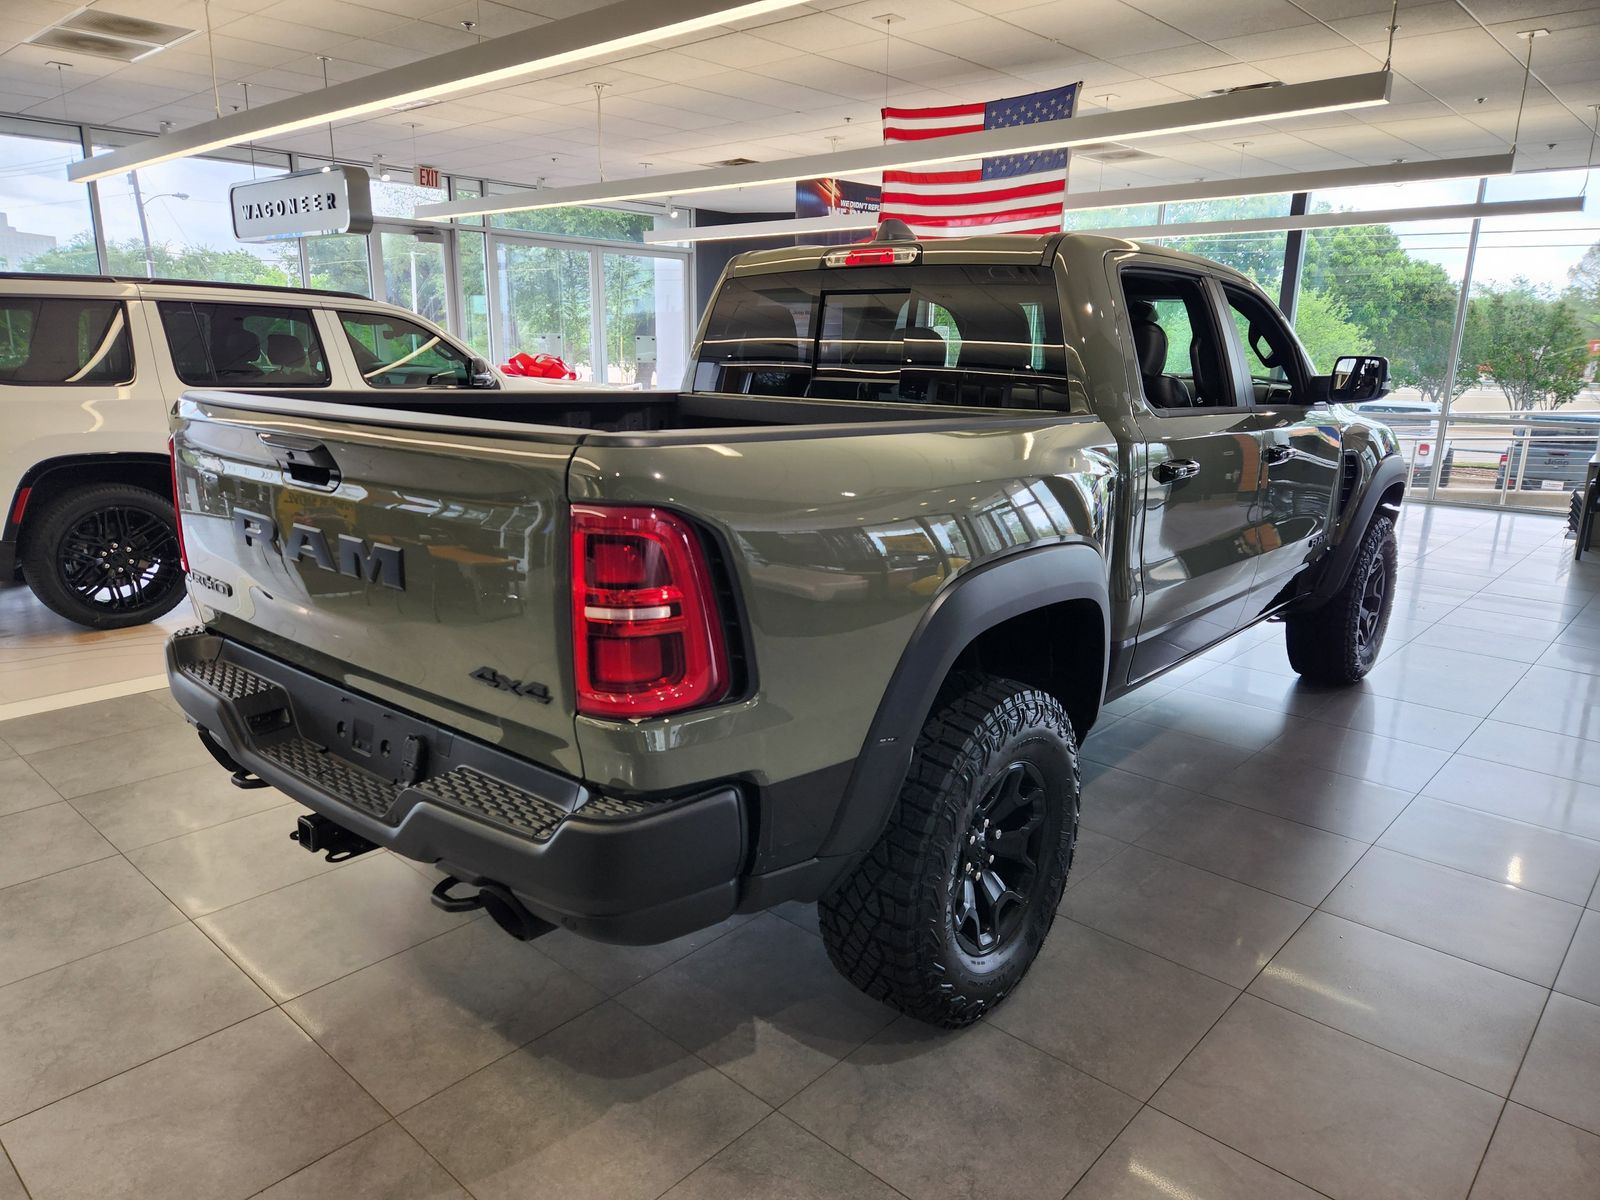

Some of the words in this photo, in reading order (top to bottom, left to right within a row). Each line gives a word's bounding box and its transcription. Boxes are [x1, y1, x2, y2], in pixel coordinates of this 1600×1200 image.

[419, 167, 439, 188] EXIT
[242, 192, 337, 220] WAGONEER
[840, 199, 849, 207] WE
[850, 201, 868, 210] DIDN'T
[868, 203, 880, 212] REPL
[1544, 458, 1568, 466] Jeep
[233, 506, 407, 592] RAM
